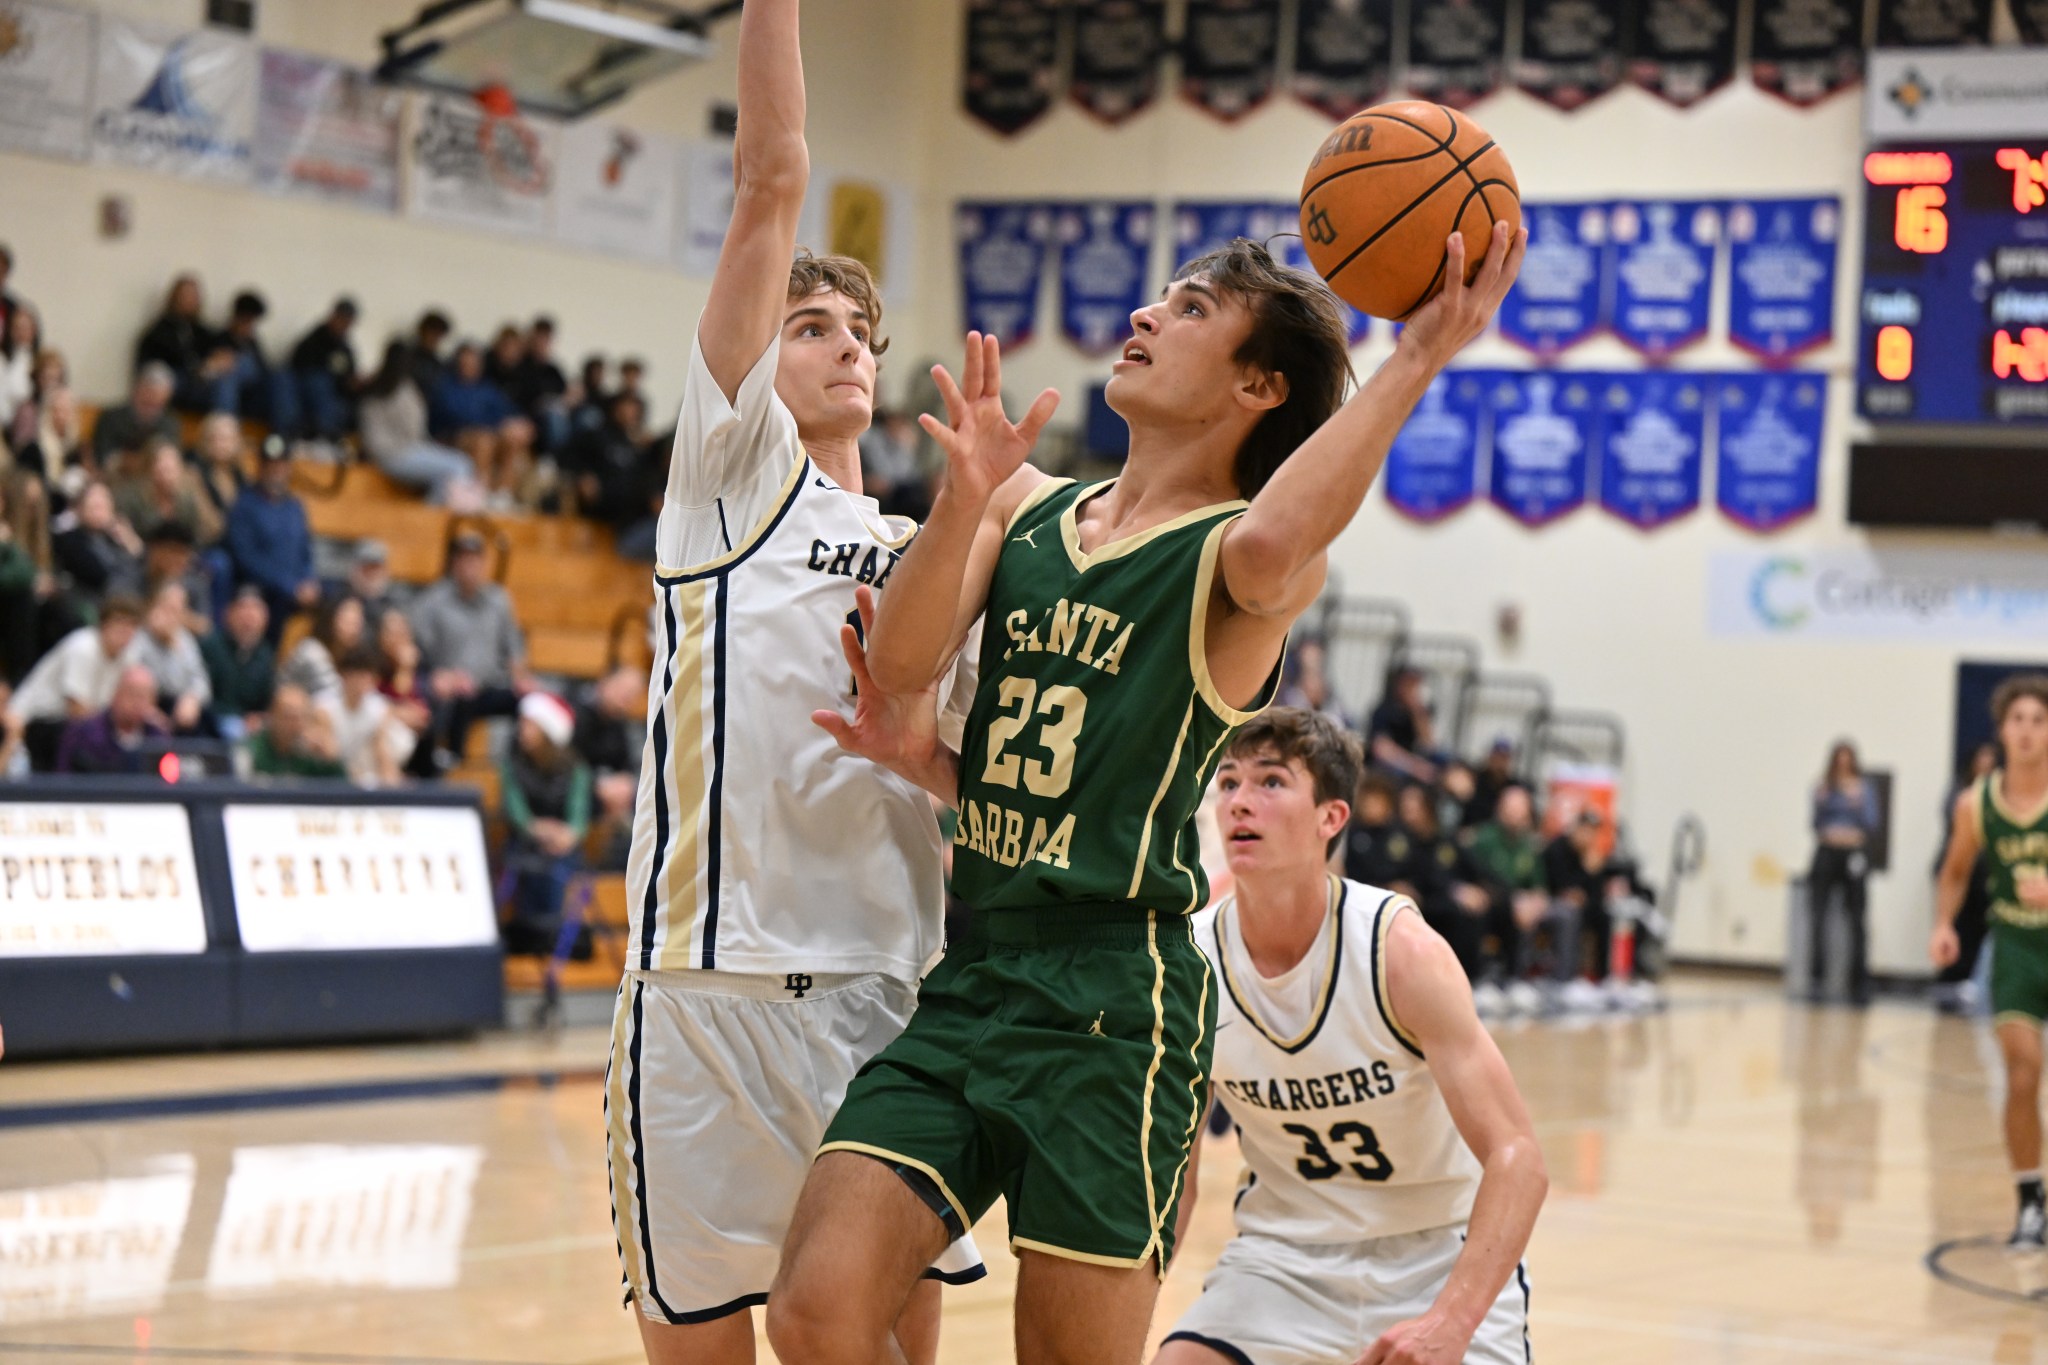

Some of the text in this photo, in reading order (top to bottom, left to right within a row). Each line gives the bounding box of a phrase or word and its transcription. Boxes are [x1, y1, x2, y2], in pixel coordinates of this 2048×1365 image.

[1003, 597, 1135, 676] SANTA
[981, 675, 1088, 799] 23
[1224, 1060, 1396, 1112] CHARGERS
[1282, 1121, 1394, 1182] 33
